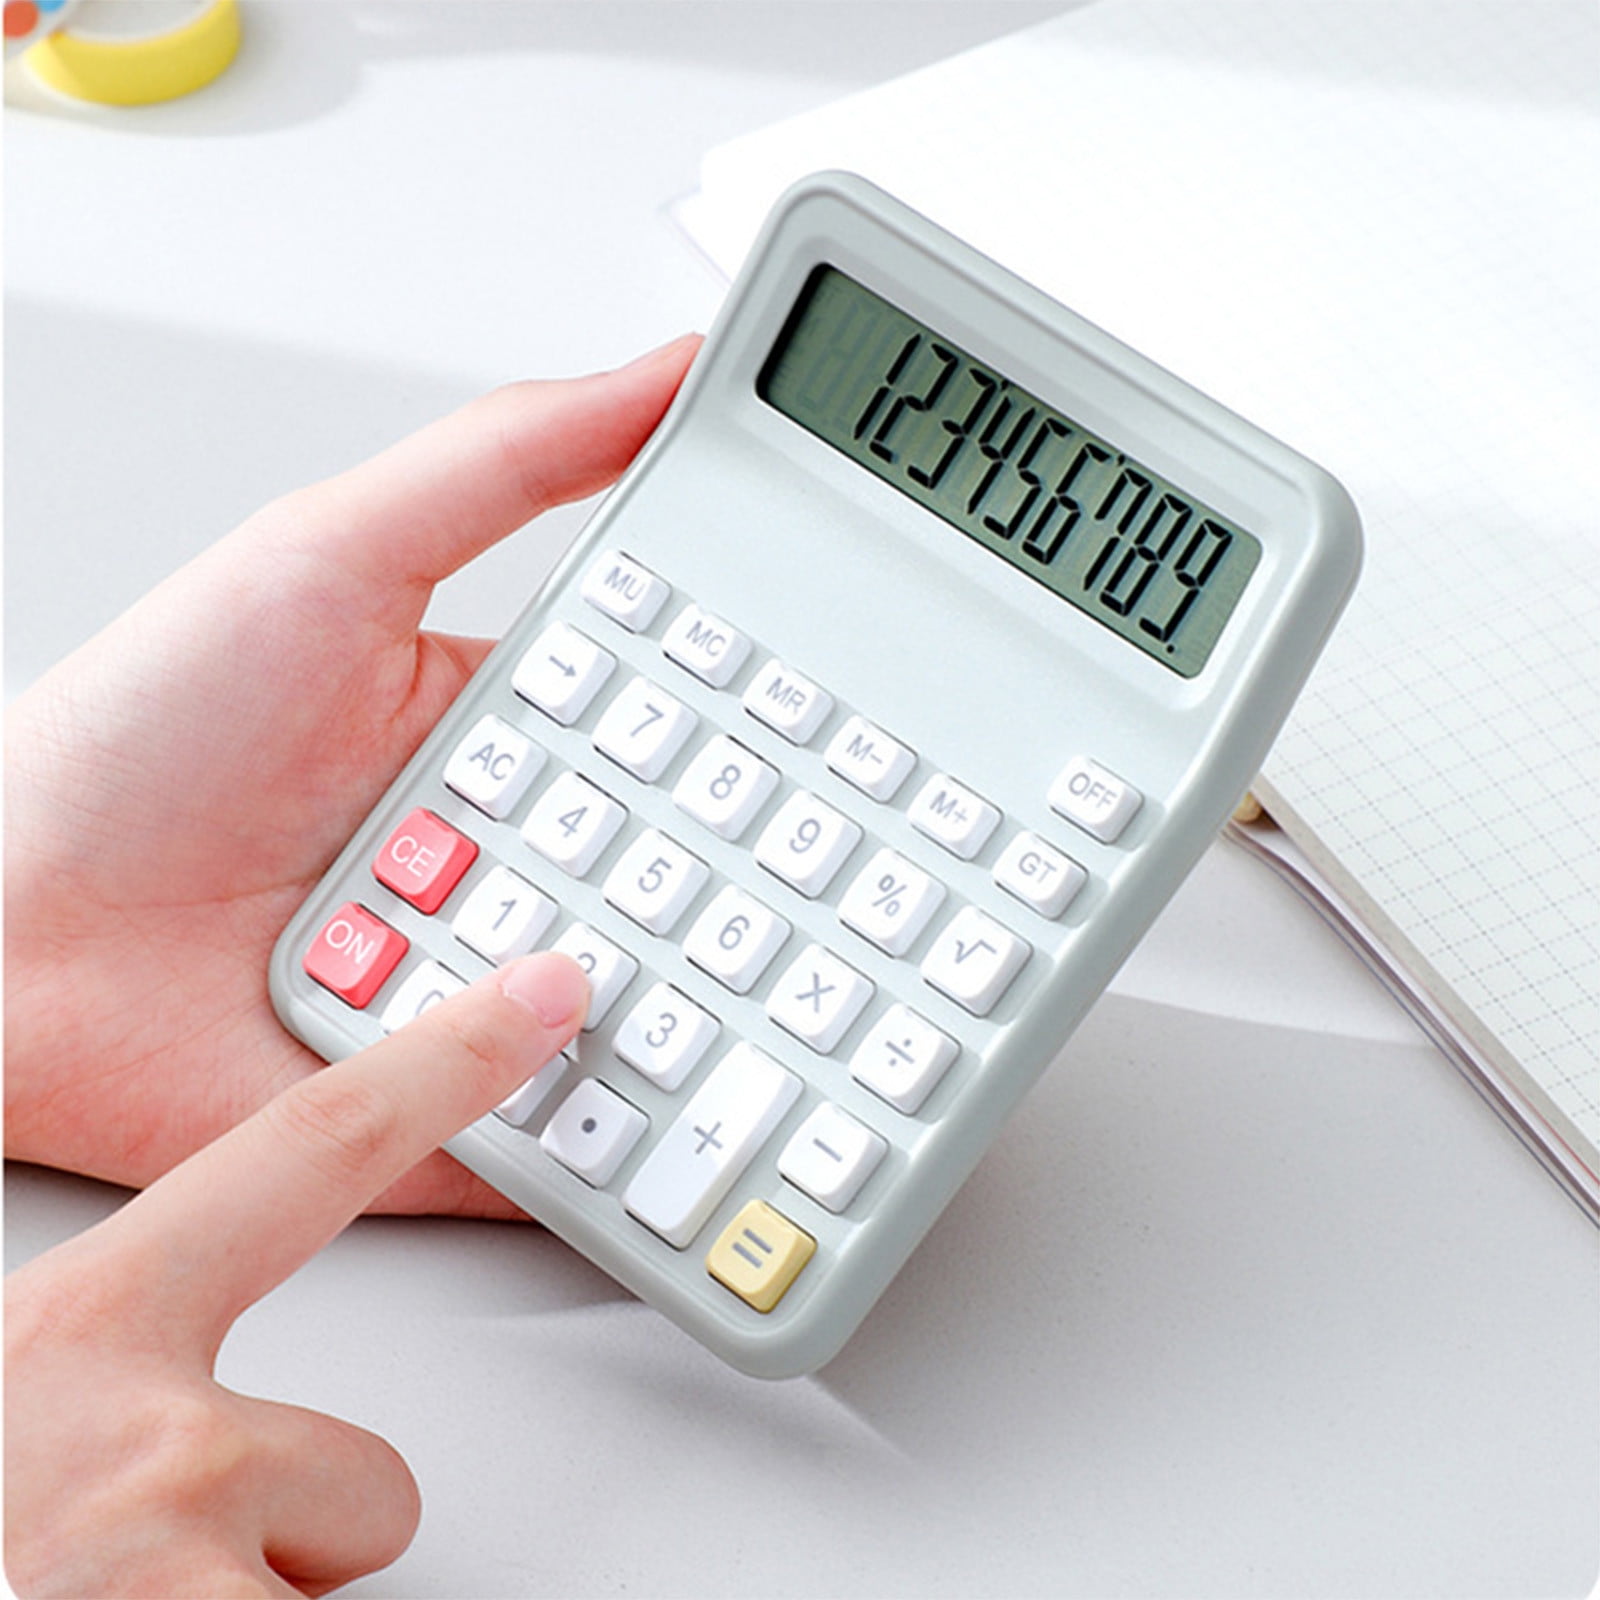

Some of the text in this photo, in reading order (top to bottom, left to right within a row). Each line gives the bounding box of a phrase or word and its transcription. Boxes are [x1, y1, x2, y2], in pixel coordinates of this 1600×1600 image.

[604, 566, 645, 602] MU
[686, 620, 727, 657] MC
[766, 677, 806, 715] MR
[629, 703, 664, 739] 7
[469, 742, 515, 781] AC
[709, 764, 742, 801] 8
[1068, 772, 1118, 811] OFF
[557, 806, 590, 838] 4
[929, 790, 968, 825] M+
[789, 819, 821, 854] 9
[390, 835, 436, 878] CE
[1018, 851, 1058, 884] GT
[638, 857, 673, 893] 5
[871, 874, 908, 917] %
[493, 899, 517, 931] 1
[718, 915, 751, 951] 6
[325, 921, 377, 965] ON
[645, 1013, 679, 1049] 3
[693, 1121, 724, 1155] +
[732, 1228, 773, 1269] =
